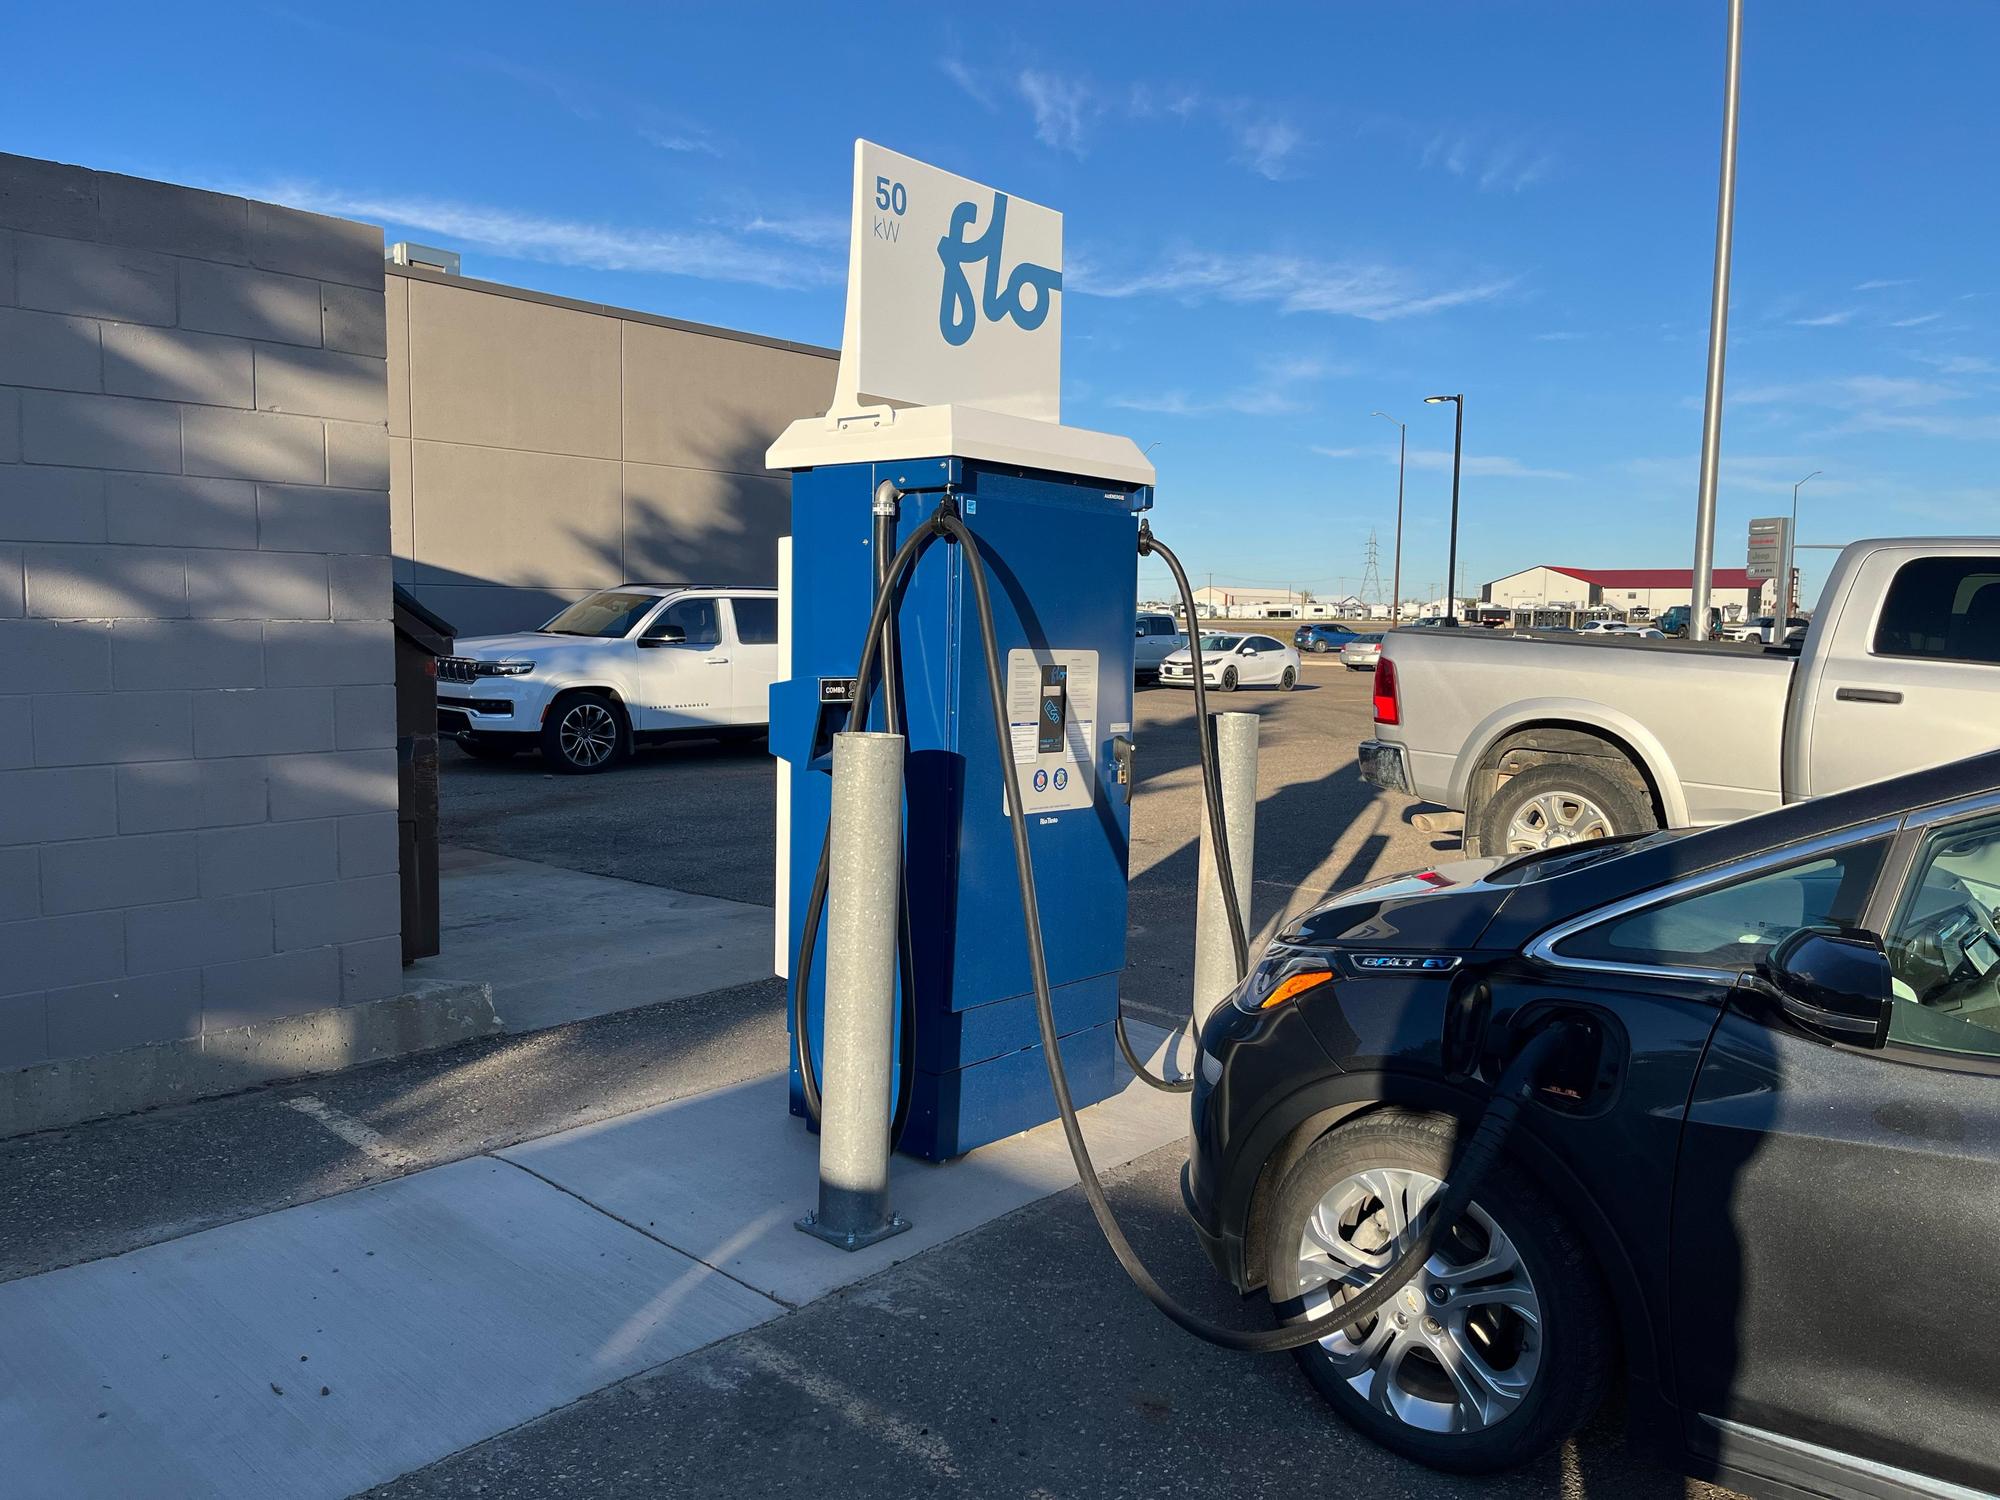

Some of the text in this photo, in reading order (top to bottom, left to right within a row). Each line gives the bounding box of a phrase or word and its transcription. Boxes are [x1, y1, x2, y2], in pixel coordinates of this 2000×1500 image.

[875, 175, 907, 216] 50
[873, 216, 900, 243] kW
[937, 191, 1063, 347] flo
[825, 686, 845, 694] COMBO
[1362, 957, 1452, 968] BOLT EV
